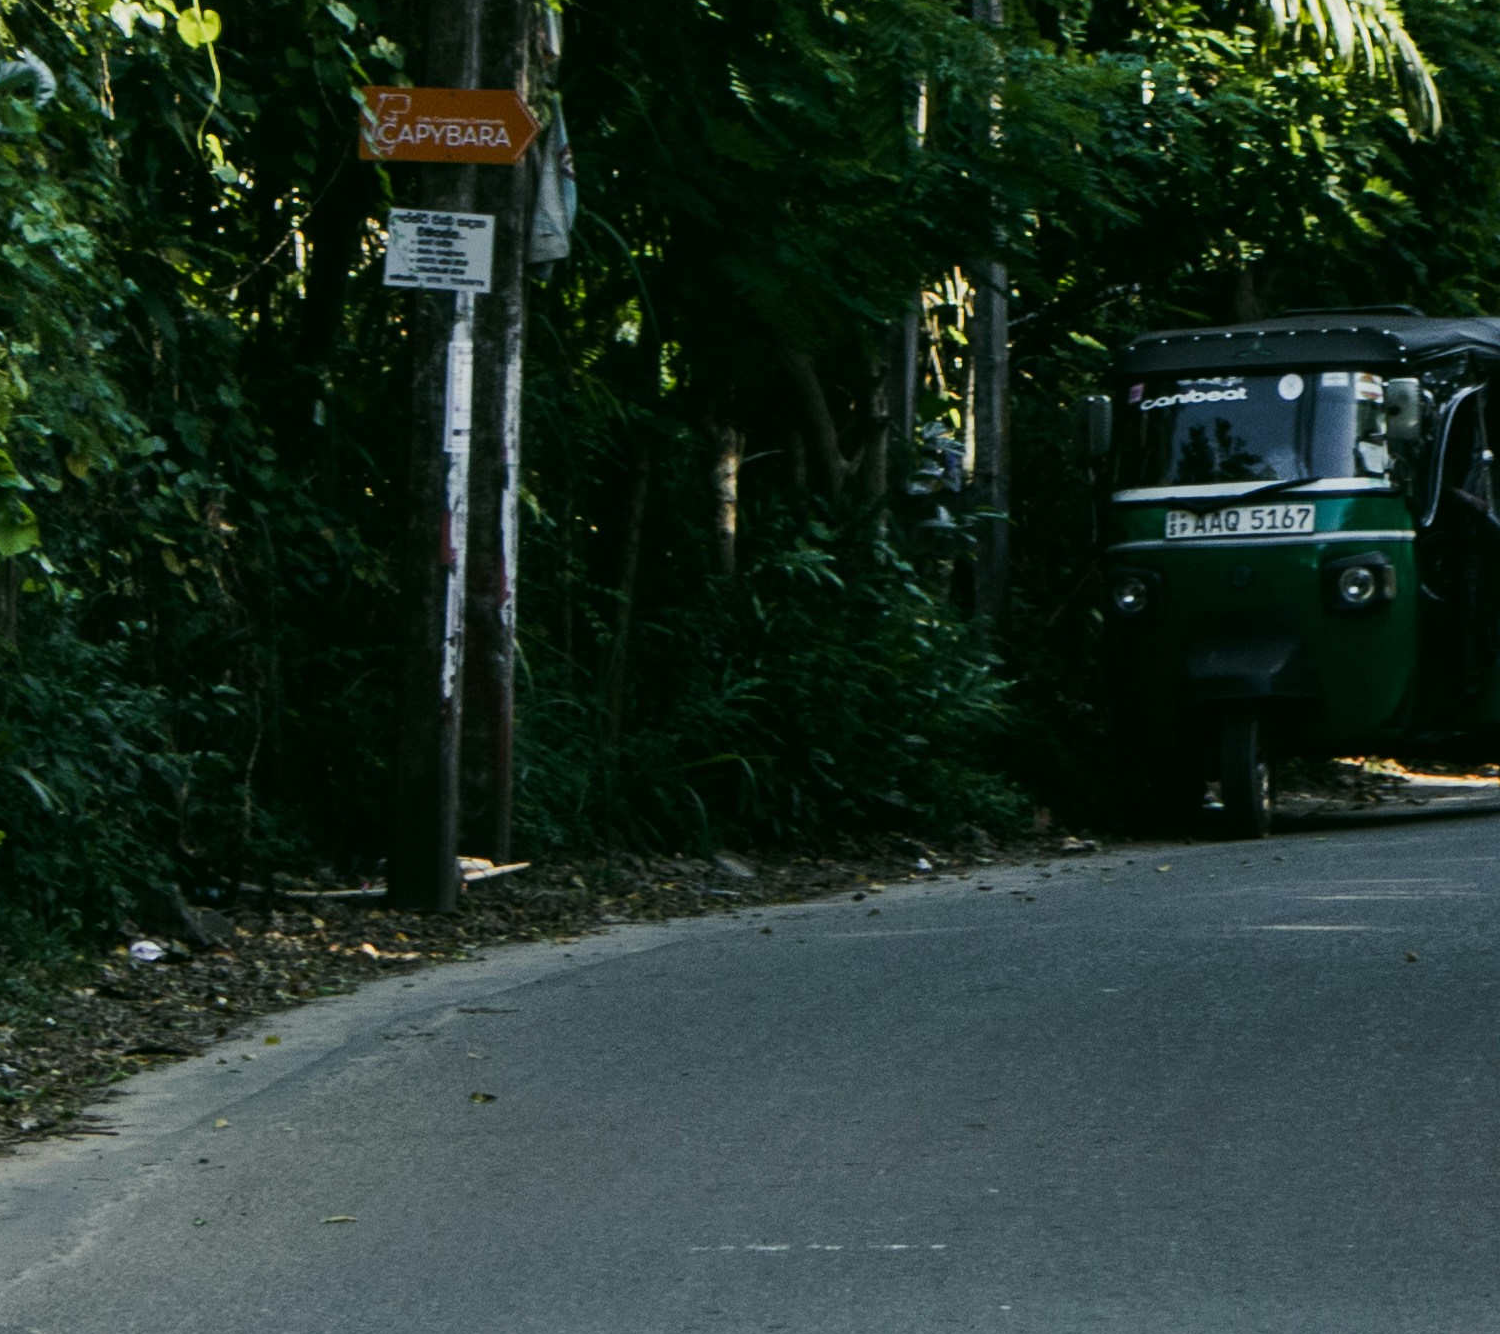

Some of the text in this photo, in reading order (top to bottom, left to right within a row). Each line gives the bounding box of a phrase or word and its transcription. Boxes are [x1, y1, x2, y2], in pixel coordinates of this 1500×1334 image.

[379, 122, 512, 148] CAPYBARA
[1192, 508, 1311, 533] AAQ 5167
